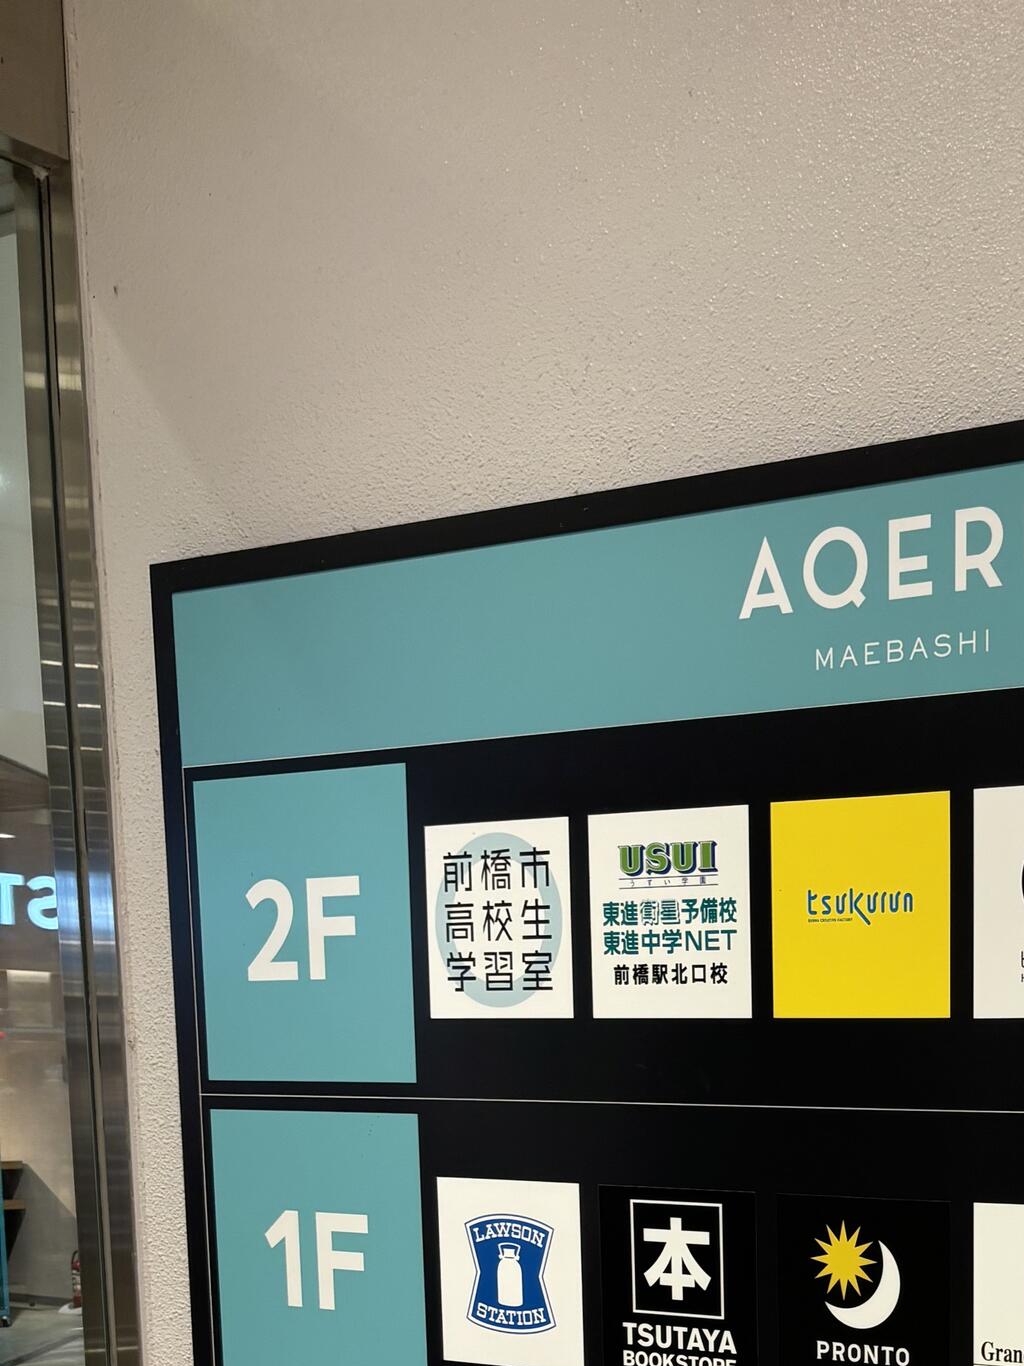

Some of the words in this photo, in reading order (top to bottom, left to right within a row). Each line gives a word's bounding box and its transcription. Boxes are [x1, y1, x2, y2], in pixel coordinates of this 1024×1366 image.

[815, 629, 990, 670] MAEBASHI
[442, 846, 550, 892] 前橋市
[618, 840, 718, 876] USUI
[444, 898, 553, 942] 高校生
[602, 897, 737, 926] 東進衛星予備校
[808, 888, 913, 925] tsukurun
[246, 875, 361, 981] 2F
[603, 929, 737, 955] 東進中学NET
[446, 950, 553, 992] 学習室
[614, 962, 728, 985] 前橋駅北口校
[472, 1223, 545, 1248] LAWSON
[264, 1209, 369, 1311] 1F
[643, 1217, 712, 1301] 本
[476, 1302, 547, 1327] STATION
[622, 1321, 737, 1354] TSUTAYA
[816, 1340, 910, 1366] PRONTO
